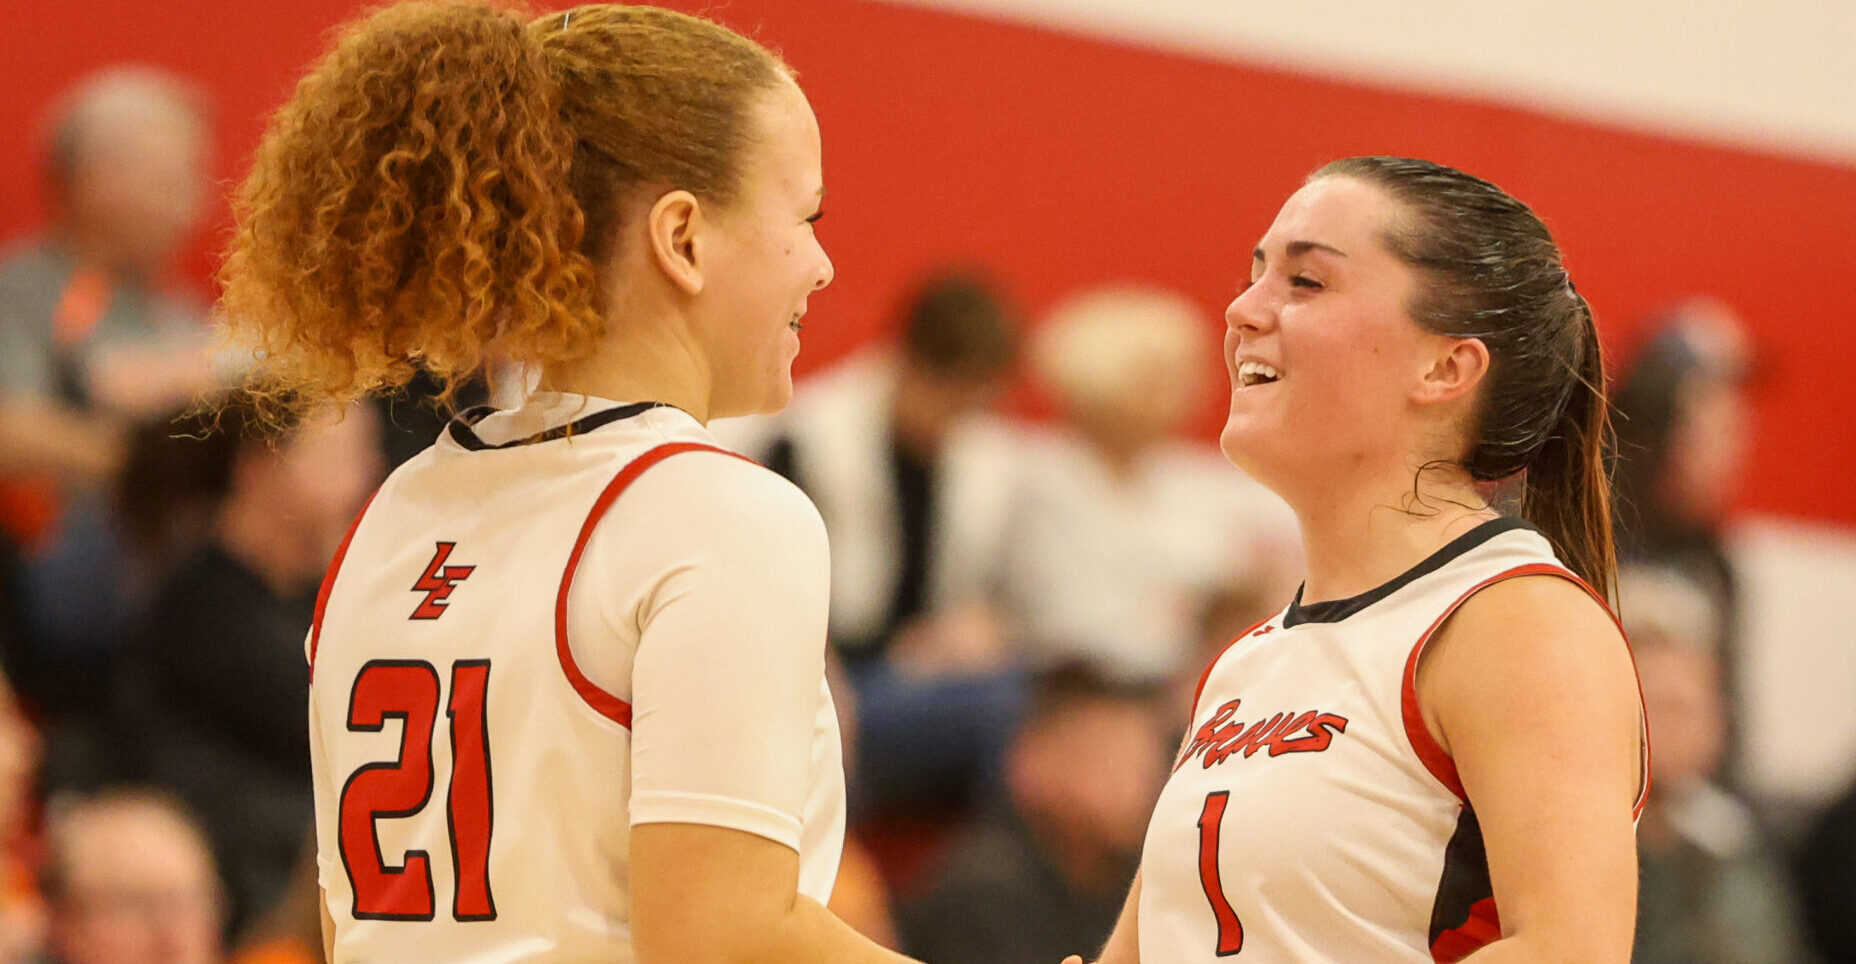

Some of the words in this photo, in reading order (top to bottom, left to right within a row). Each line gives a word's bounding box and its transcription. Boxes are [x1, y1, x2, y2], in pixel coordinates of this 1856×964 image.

[409, 541, 477, 619] LE
[338, 659, 497, 922] 21
[1173, 699, 1349, 772] Braves
[1197, 790, 1243, 957] 1
